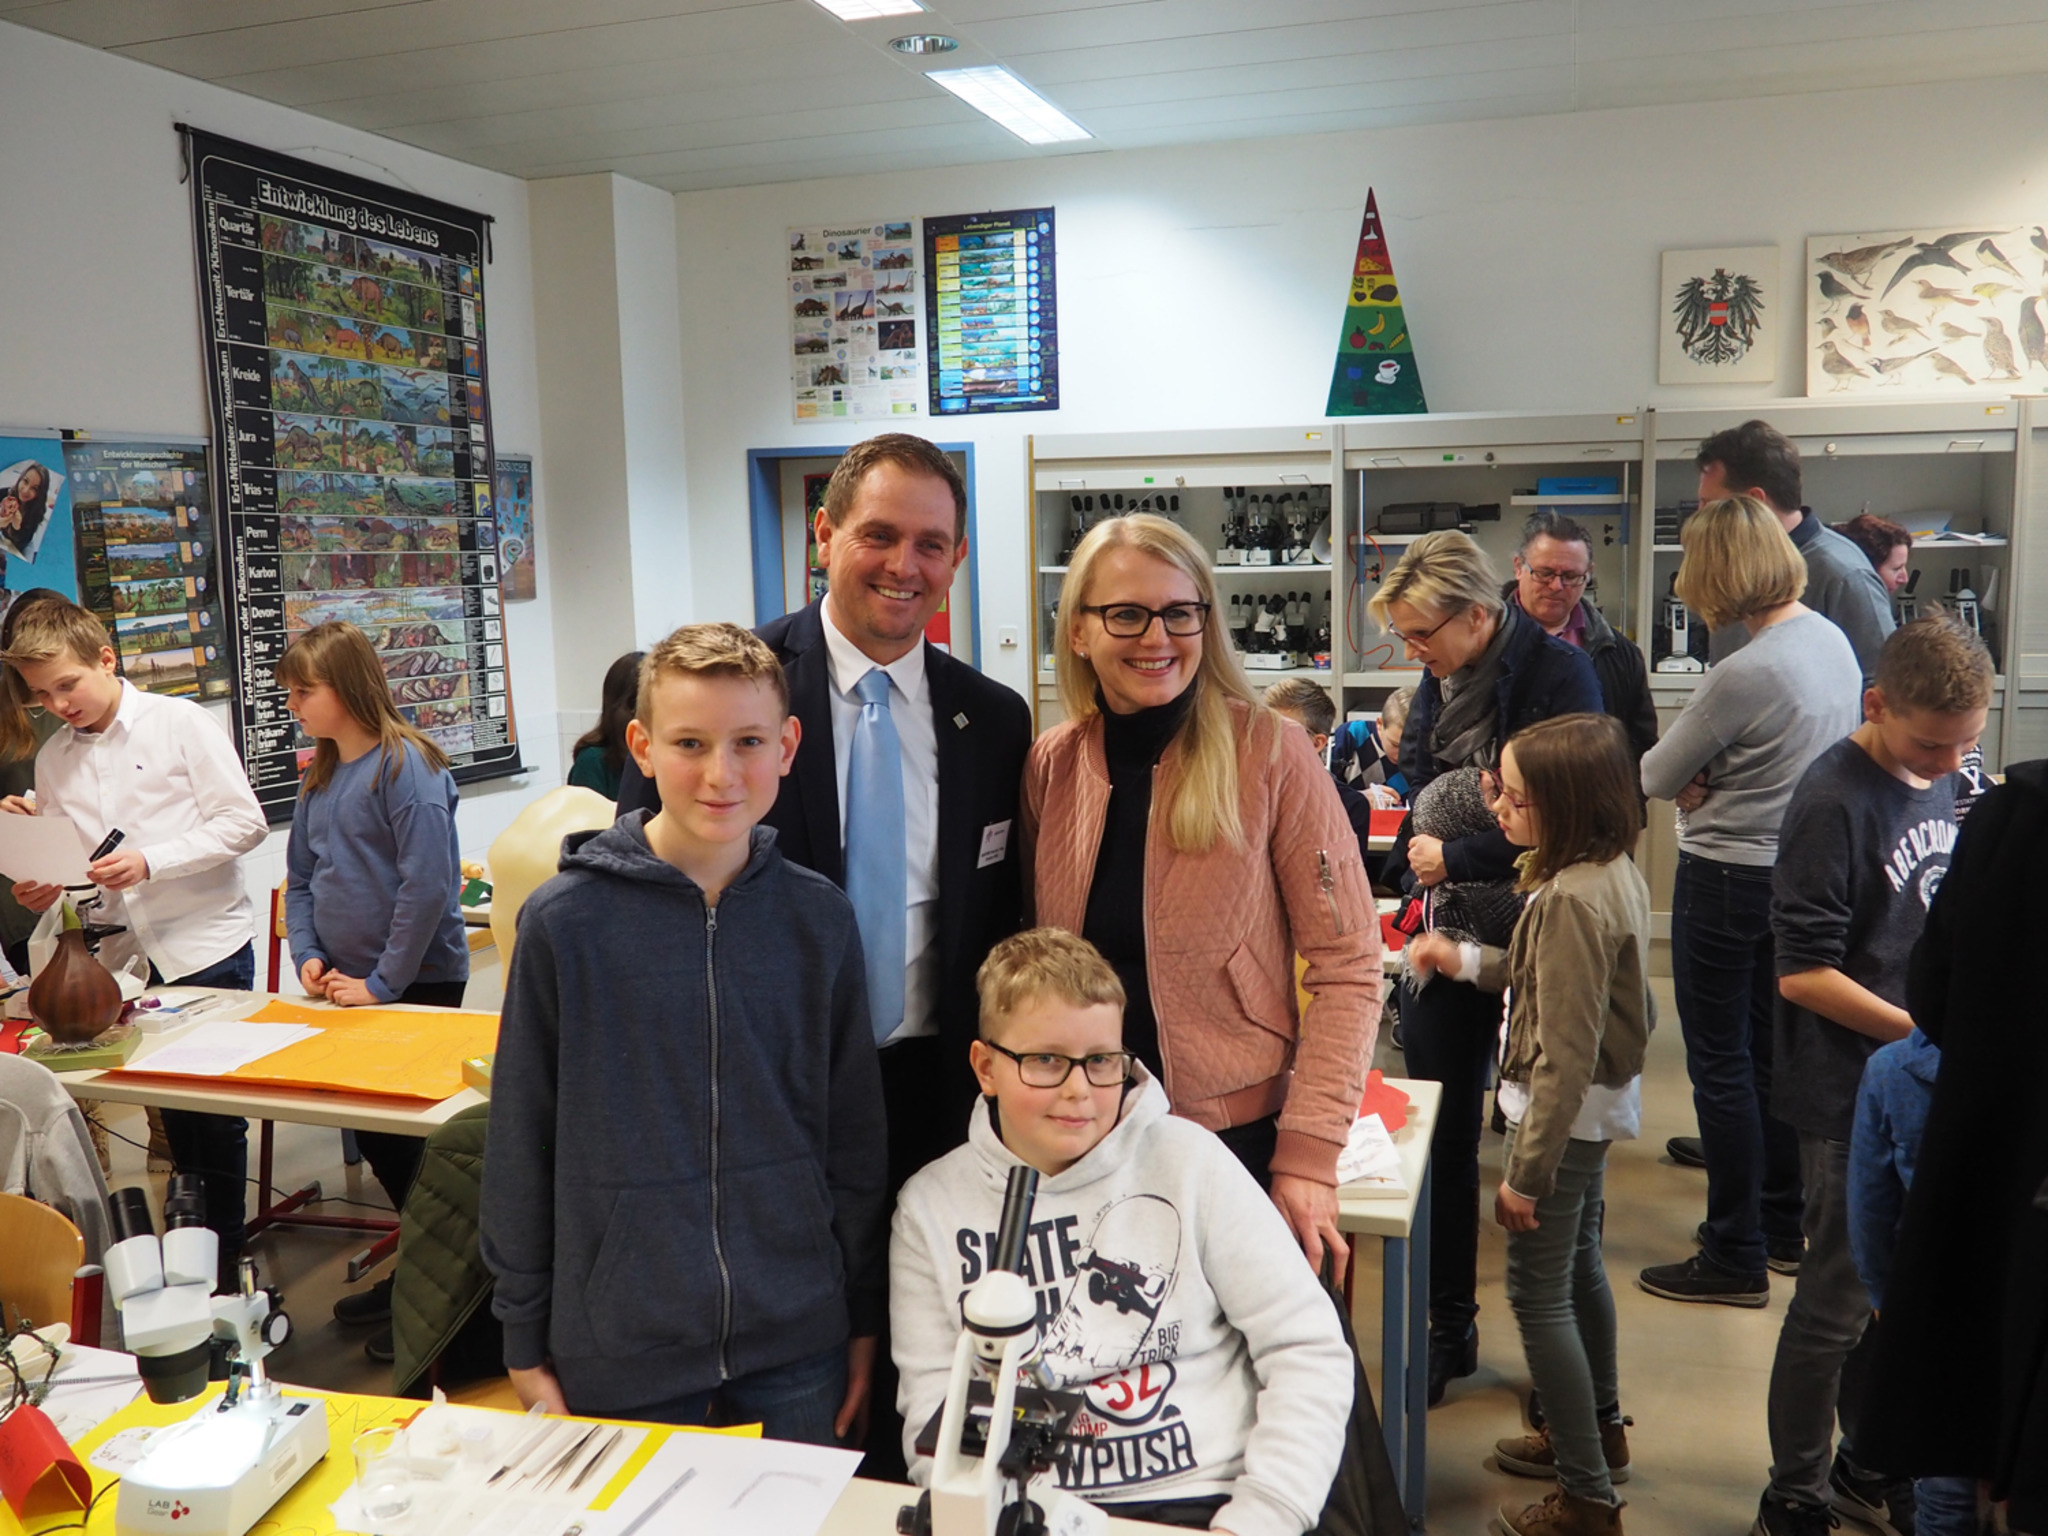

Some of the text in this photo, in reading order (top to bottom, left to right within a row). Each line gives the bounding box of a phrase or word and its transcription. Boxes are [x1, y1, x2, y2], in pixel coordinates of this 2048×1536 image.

[257, 178, 357, 231] Entwicklung
[357, 207, 386, 235] des
[386, 213, 440, 248] Lebens
[219, 217, 255, 236] Quartär
[822, 226, 872, 238] Dinosaurier
[224, 285, 255, 302] Tertiär
[233, 366, 262, 383] Kreide
[238, 429, 257, 443] Jura
[103, 450, 184, 460] Entwicklungsgeschichte
[133, 461, 168, 470] Menschen
[242, 482, 262, 496] Trias
[246, 526, 268, 539] Perm
[249, 566, 277, 579] Karbon
[239, 606, 250, 630] oder
[251, 606, 275, 619] Devon
[253, 640, 271, 653] Silur
[241, 636, 254, 706] Erd-Altertum
[1884, 819, 1959, 893] ABERCROM
[1157, 1325, 1180, 1346] BIG
[1139, 1345, 1179, 1364] TRICK
[1070, 1422, 1108, 1437] COMP
[148, 1499, 170, 1510] LAB
[147, 1508, 169, 1517] Gear
